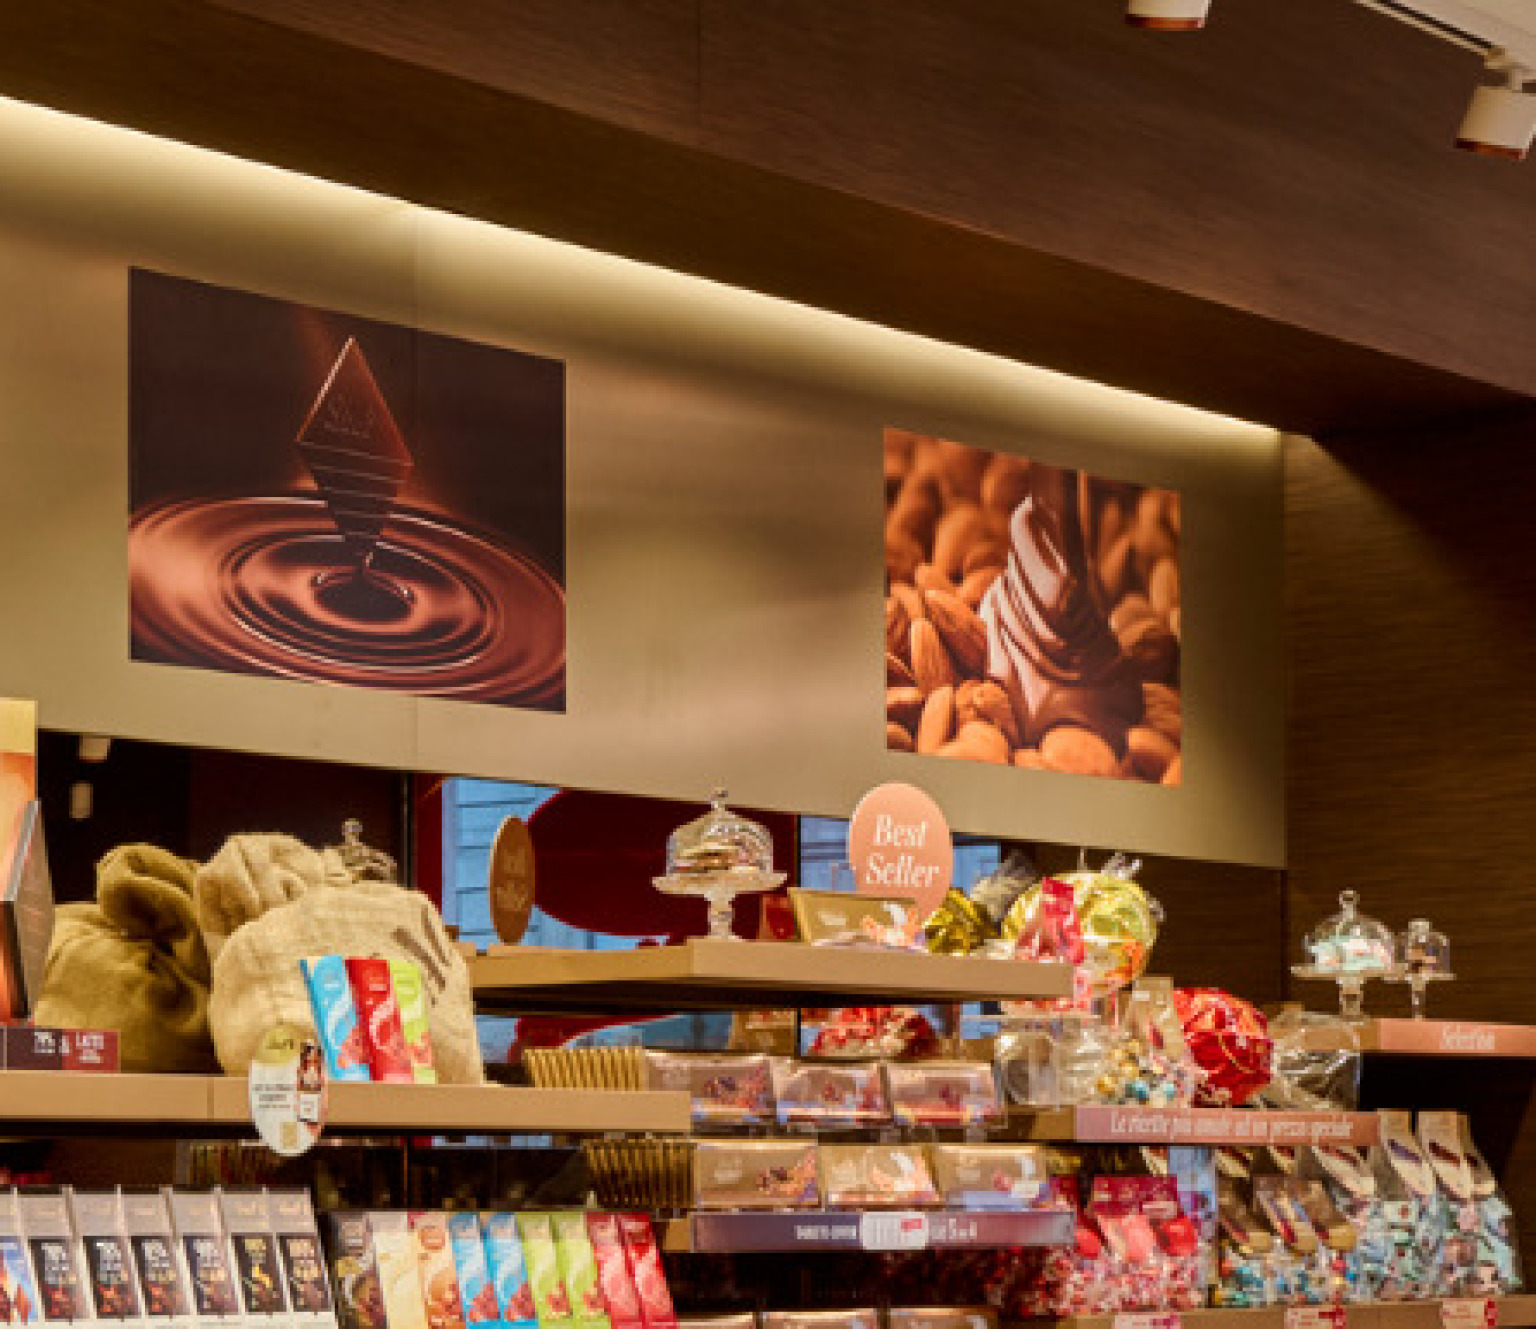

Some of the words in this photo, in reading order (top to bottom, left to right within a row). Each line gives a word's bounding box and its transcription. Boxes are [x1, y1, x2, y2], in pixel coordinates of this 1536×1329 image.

[874, 814, 929, 849] Best
[866, 851, 940, 889] Seller
[1110, 1111, 1126, 1134] Le
